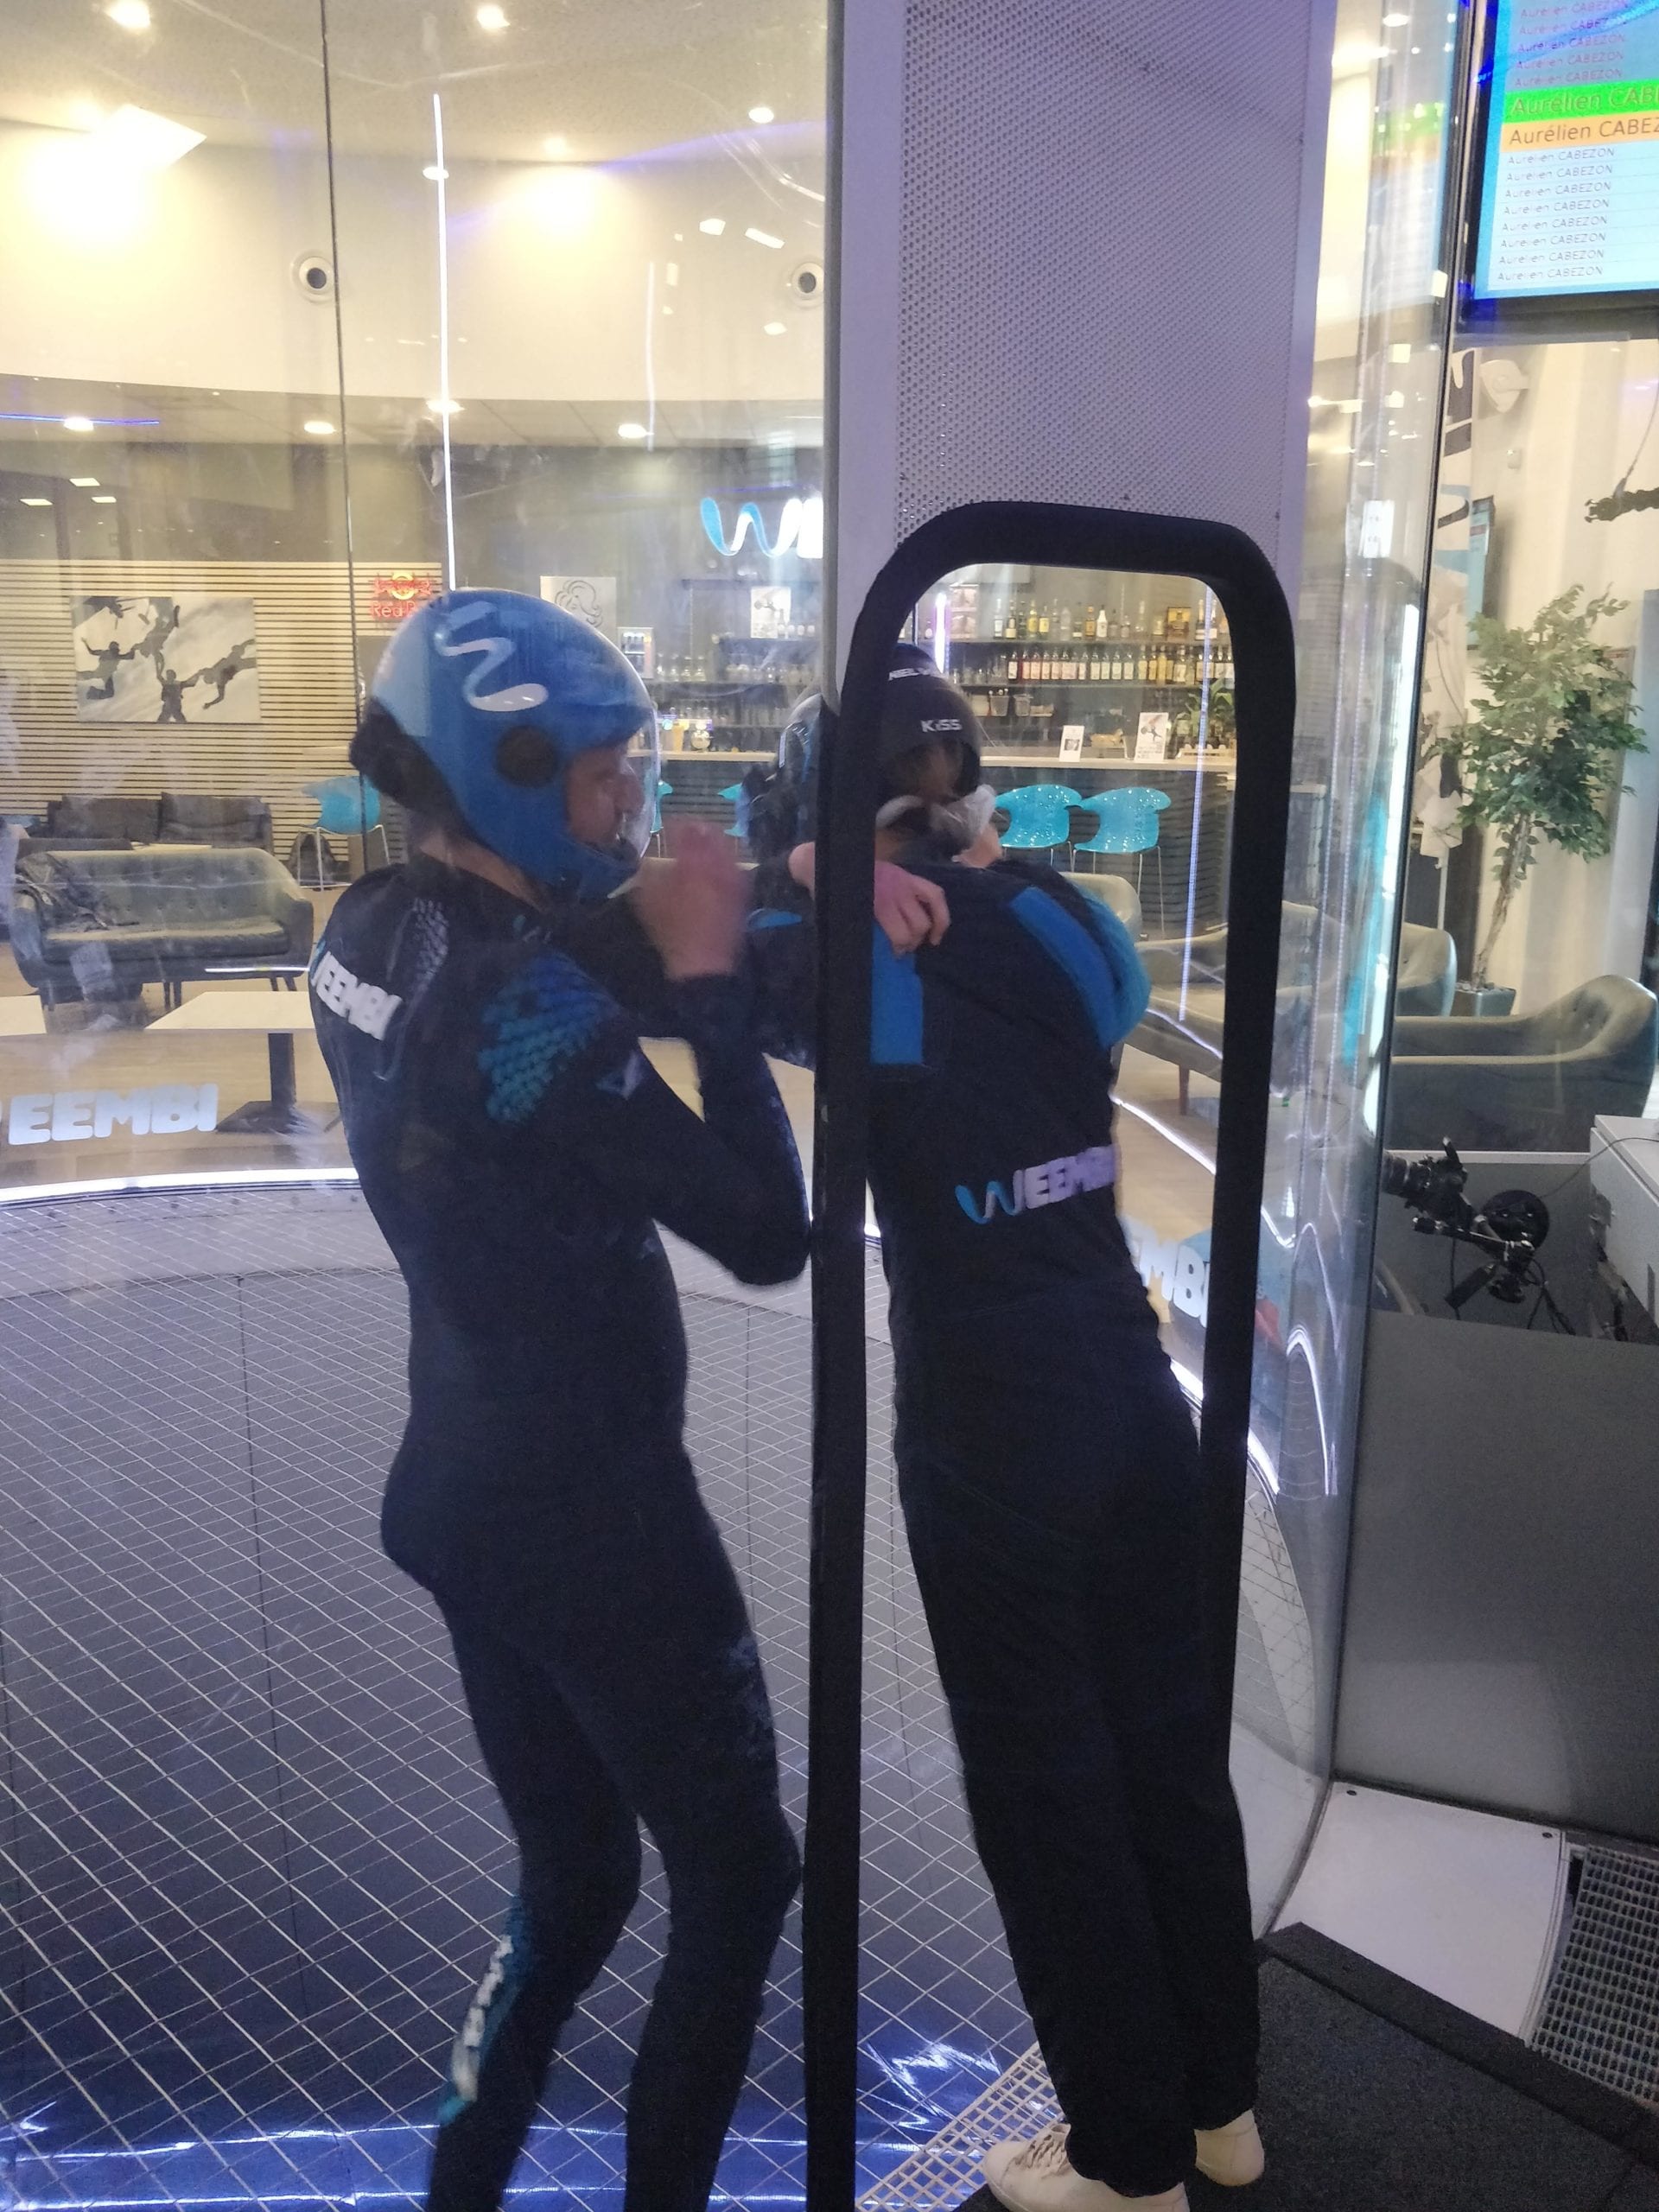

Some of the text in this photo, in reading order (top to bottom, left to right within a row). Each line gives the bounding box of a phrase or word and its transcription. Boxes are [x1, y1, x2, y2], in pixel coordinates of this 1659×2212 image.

[1567, 51, 1624, 65] CABEZON
[1566, 68, 1622, 82] CABEZON
[1609, 86, 1659, 108] CAB
[1510, 124, 1592, 145] Aurélien
[1558, 148, 1615, 162] CABEZON
[1556, 165, 1613, 178] CABEZON
[1554, 181, 1611, 194] CABEZON
[1553, 199, 1609, 212] CABEZON
[1551, 216, 1607, 228] CABEZON
[1549, 232, 1606, 245] CABEZON
[1548, 249, 1605, 262] CABEZON
[1547, 266, 1603, 278] CABEZON
